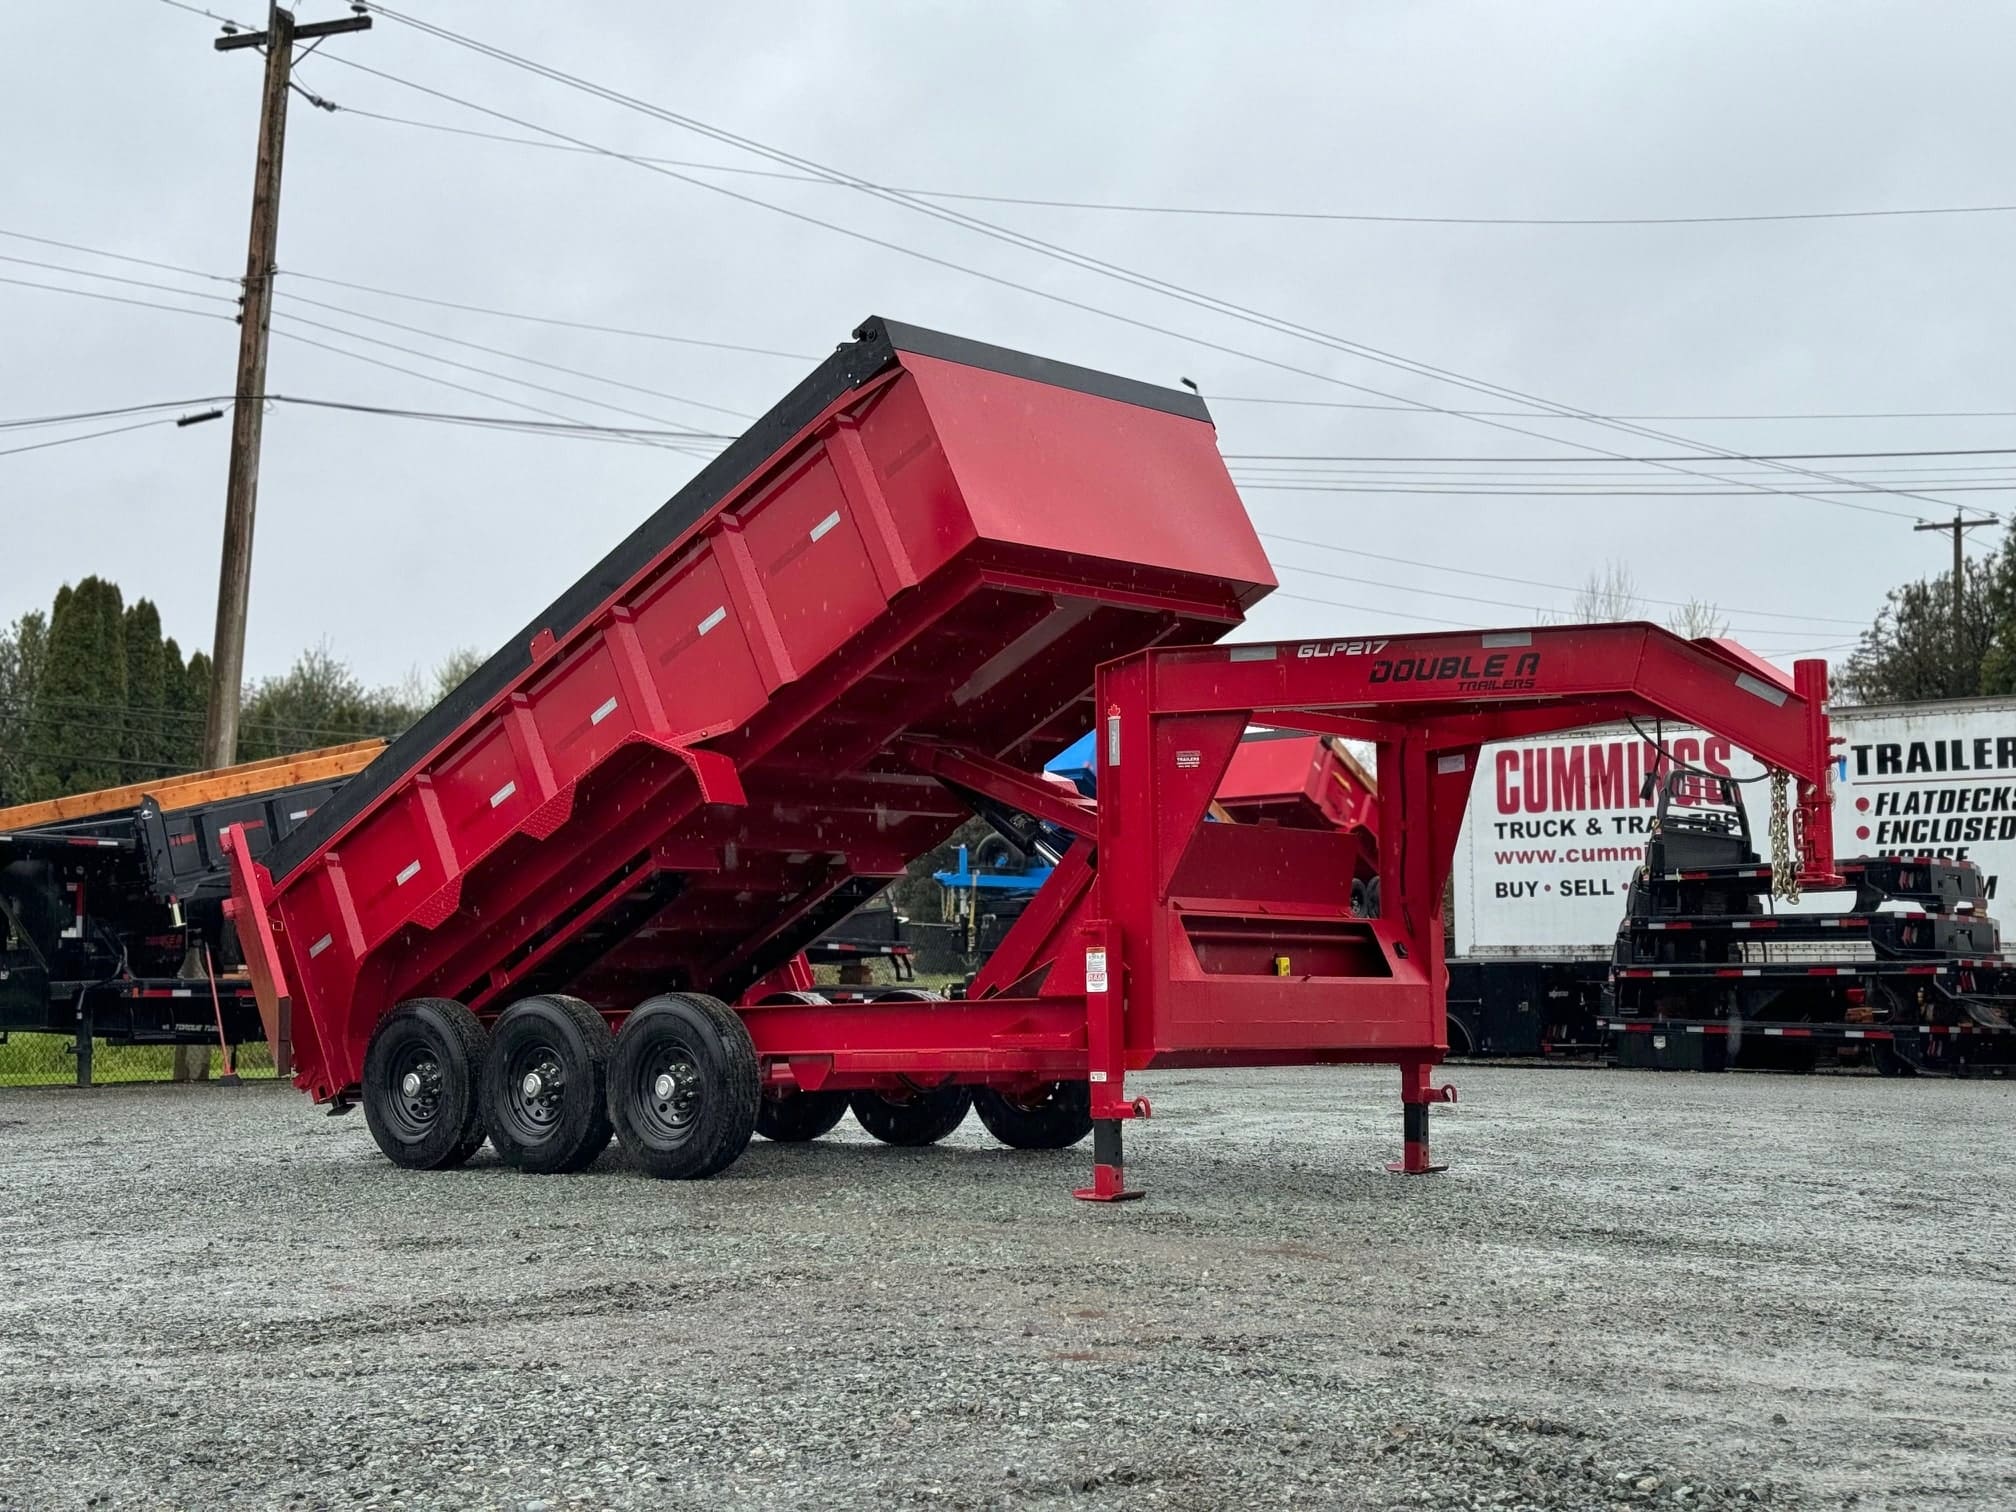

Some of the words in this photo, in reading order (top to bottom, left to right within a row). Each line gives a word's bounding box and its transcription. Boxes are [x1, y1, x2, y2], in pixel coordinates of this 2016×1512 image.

[1297, 640, 1390, 659] GLP217
[1369, 654, 1510, 684] DOUBLE
[1457, 679, 1536, 692] TRAILERS
[1851, 737, 2016, 775] TRAILER
[1495, 736, 1733, 815] CUMMINGS
[1875, 786, 2016, 816] FLATDECK
[1494, 819, 1577, 840] TRUCK
[1586, 818, 1602, 835] &
[1612, 812, 1740, 835] TRAERS
[1876, 815, 2016, 845] ENCLOSED
[1495, 881, 1538, 898] BUY
[1560, 879, 1614, 896] SELL
